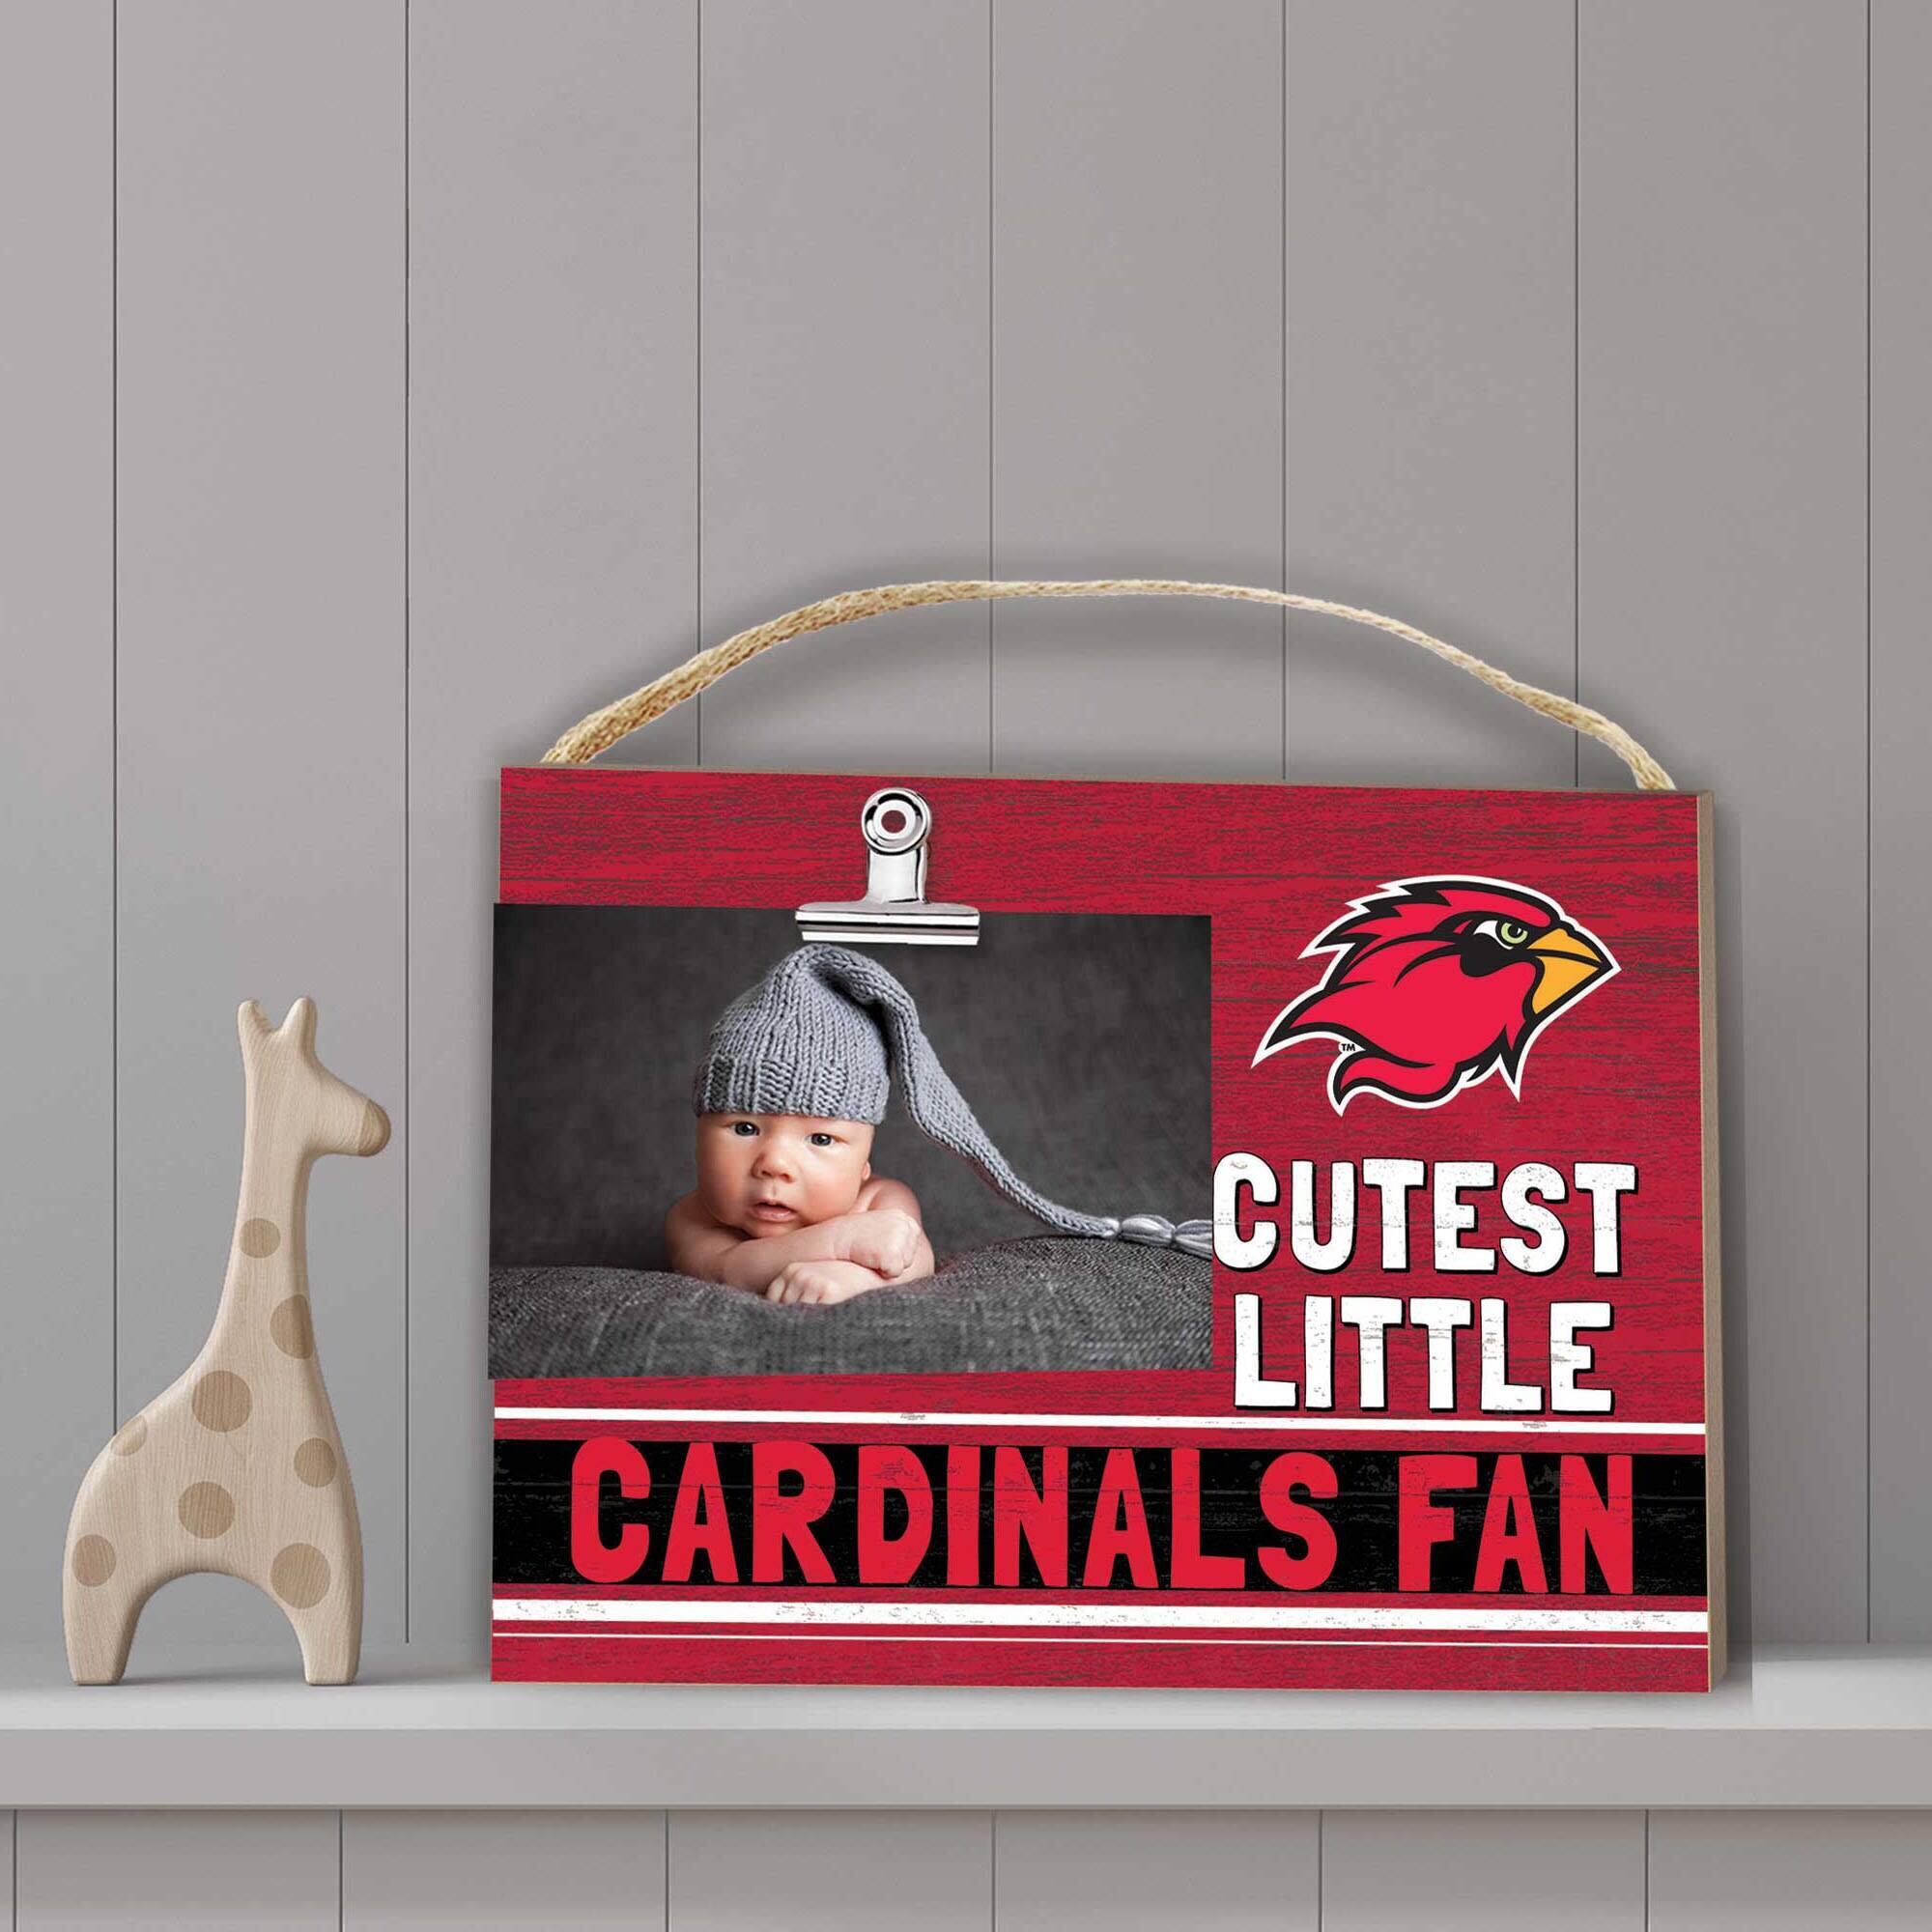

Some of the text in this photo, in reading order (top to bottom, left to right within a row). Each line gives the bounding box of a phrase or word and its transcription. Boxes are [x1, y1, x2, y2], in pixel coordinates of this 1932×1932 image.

[1341, 1043, 1356, 1052] TM
[1212, 1151, 1637, 1276] CUTEST
[1233, 1293, 1614, 1414] LITTLE
[571, 1436, 1634, 1595] CARDINALS FAN
